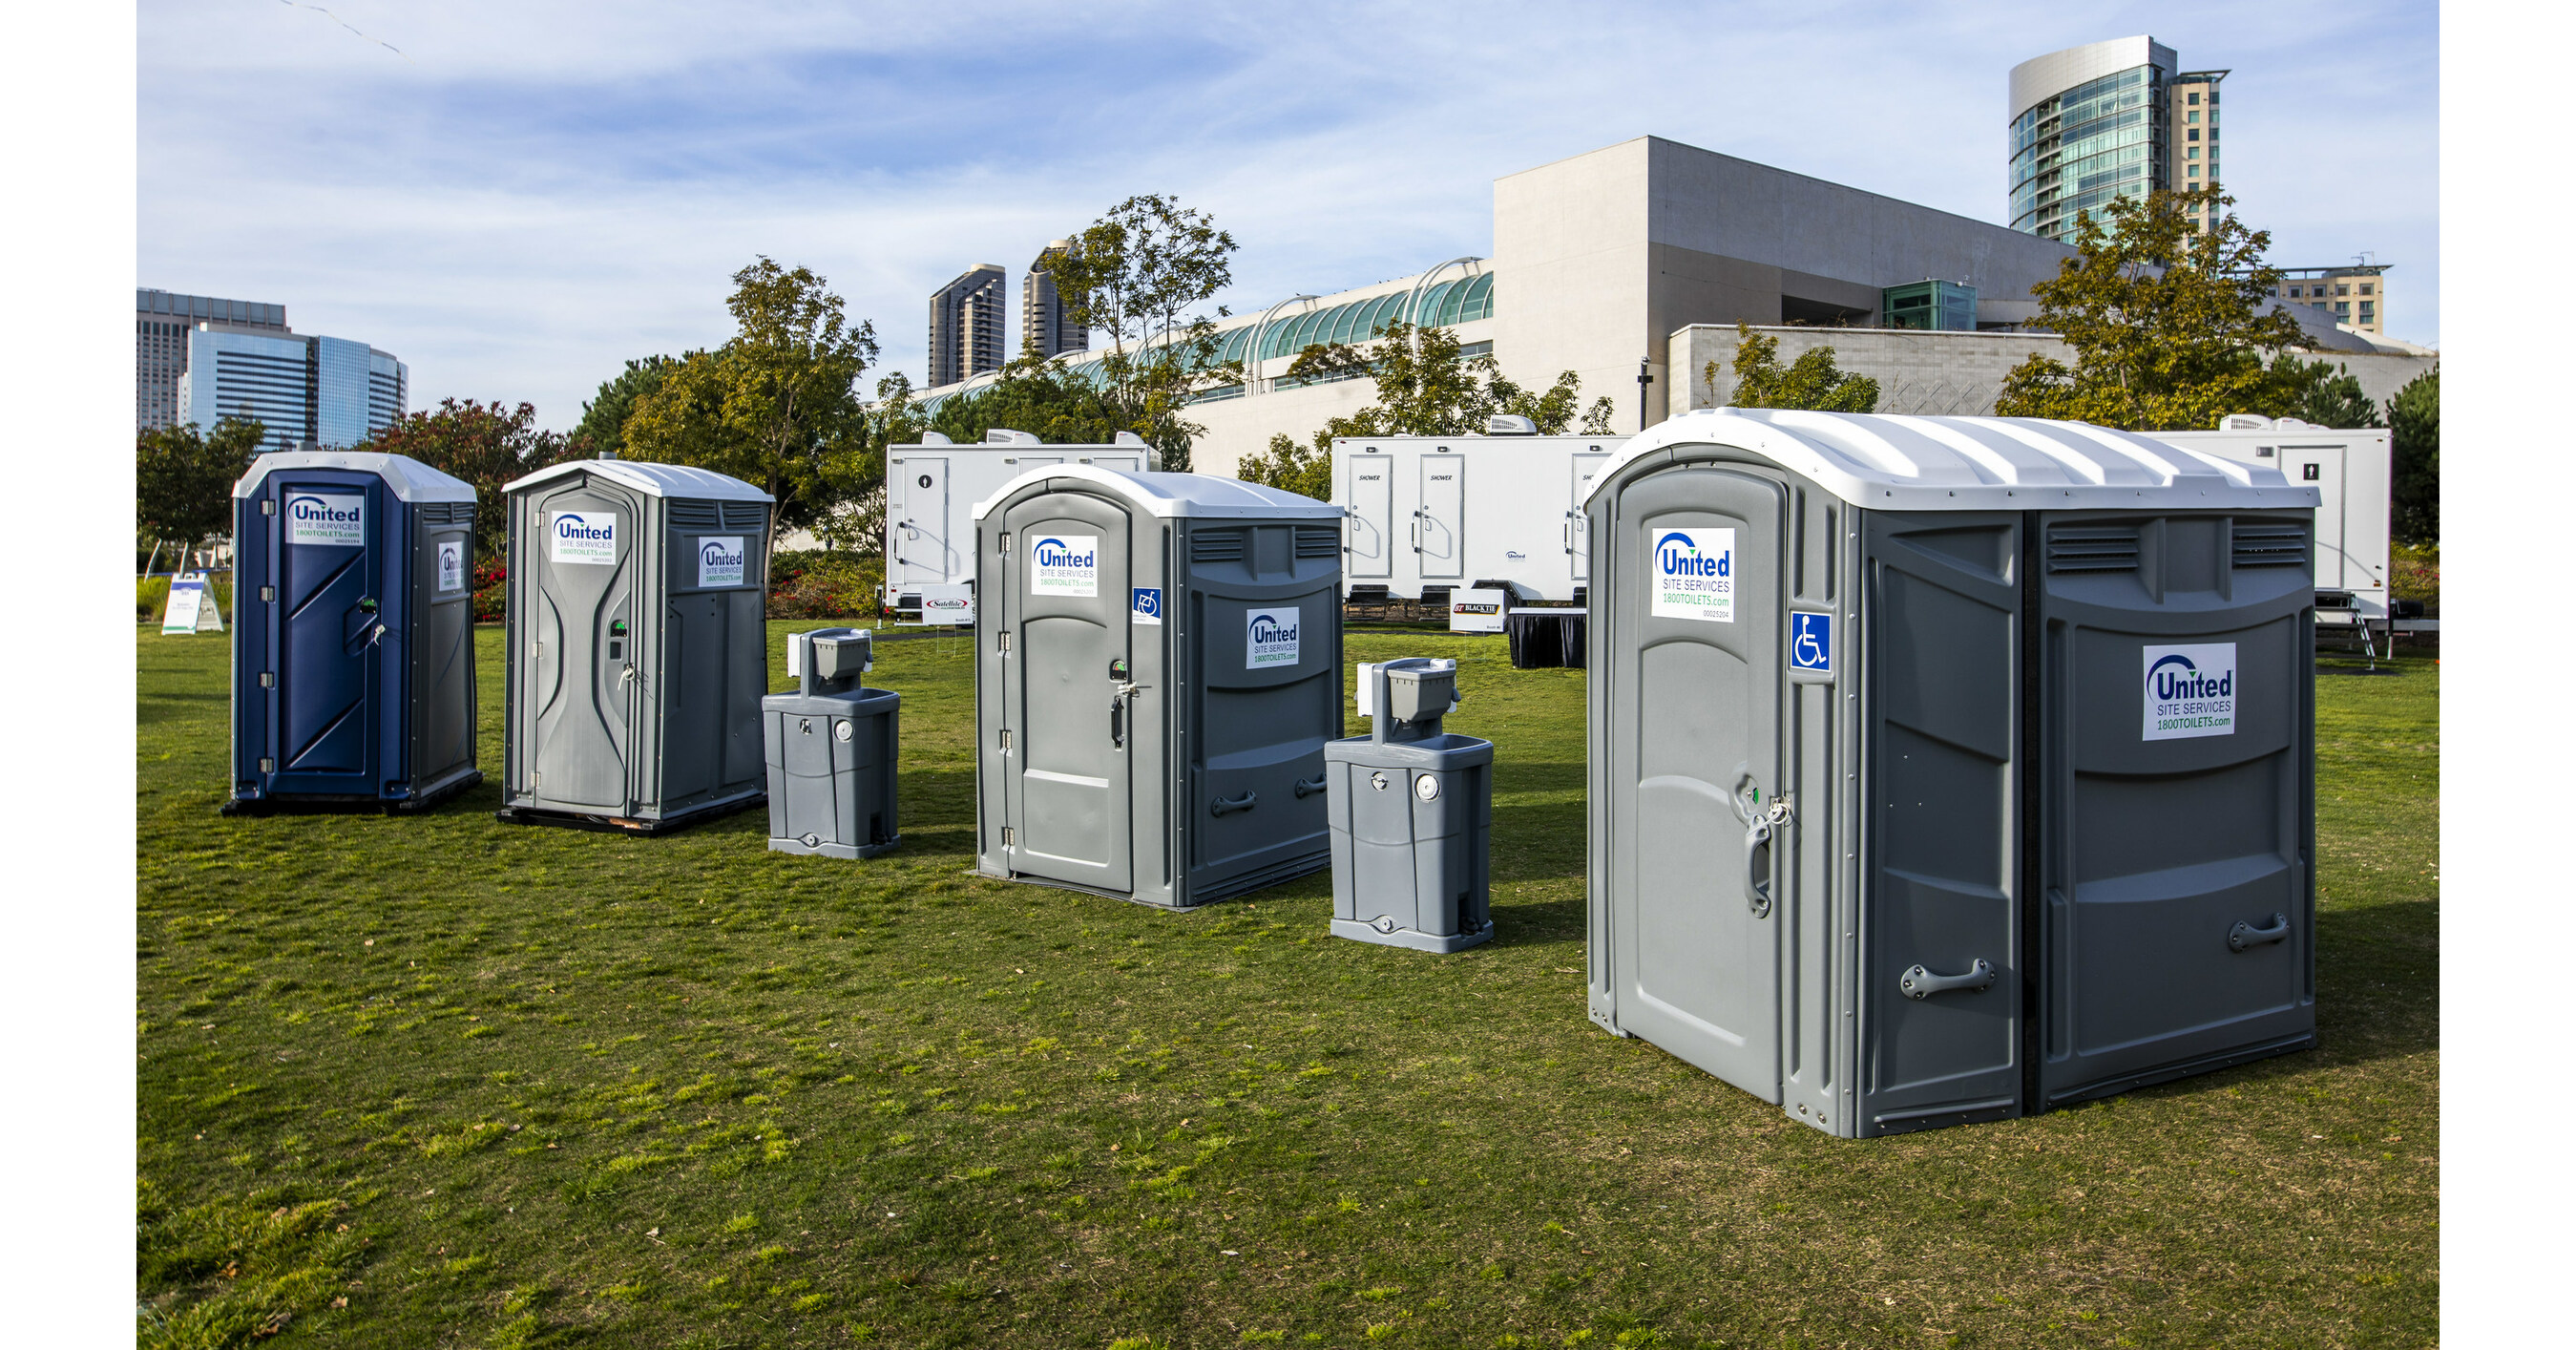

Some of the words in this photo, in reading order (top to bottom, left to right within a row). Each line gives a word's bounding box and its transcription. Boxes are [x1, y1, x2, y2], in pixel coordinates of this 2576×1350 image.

[295, 505, 360, 521] United
[296, 521, 313, 530] SITE
[316, 522, 360, 531] SERVICES
[560, 523, 613, 539] United
[576, 540, 613, 549] SERVICES
[706, 551, 742, 566] United
[1040, 549, 1094, 568] United
[1663, 549, 1729, 577] United
[1058, 570, 1095, 579] SERVICES
[1041, 579, 1095, 587] 1800TOILETS.com
[1663, 579, 1682, 590] SITE
[1684, 580, 1729, 593] SERVICES
[1663, 593, 1729, 607] 1800TOILETS.com
[1254, 623, 1297, 643] United
[1254, 645, 1267, 654] SITE
[1269, 643, 1297, 652] SERVICES
[1254, 653, 1297, 663] 1800TOILETS.com
[2157, 670, 2231, 701] United
[2157, 704, 2180, 716] SITE
[2183, 701, 2231, 715] SERVICES
[2157, 716, 2230, 730] 1800TOILETS.com
